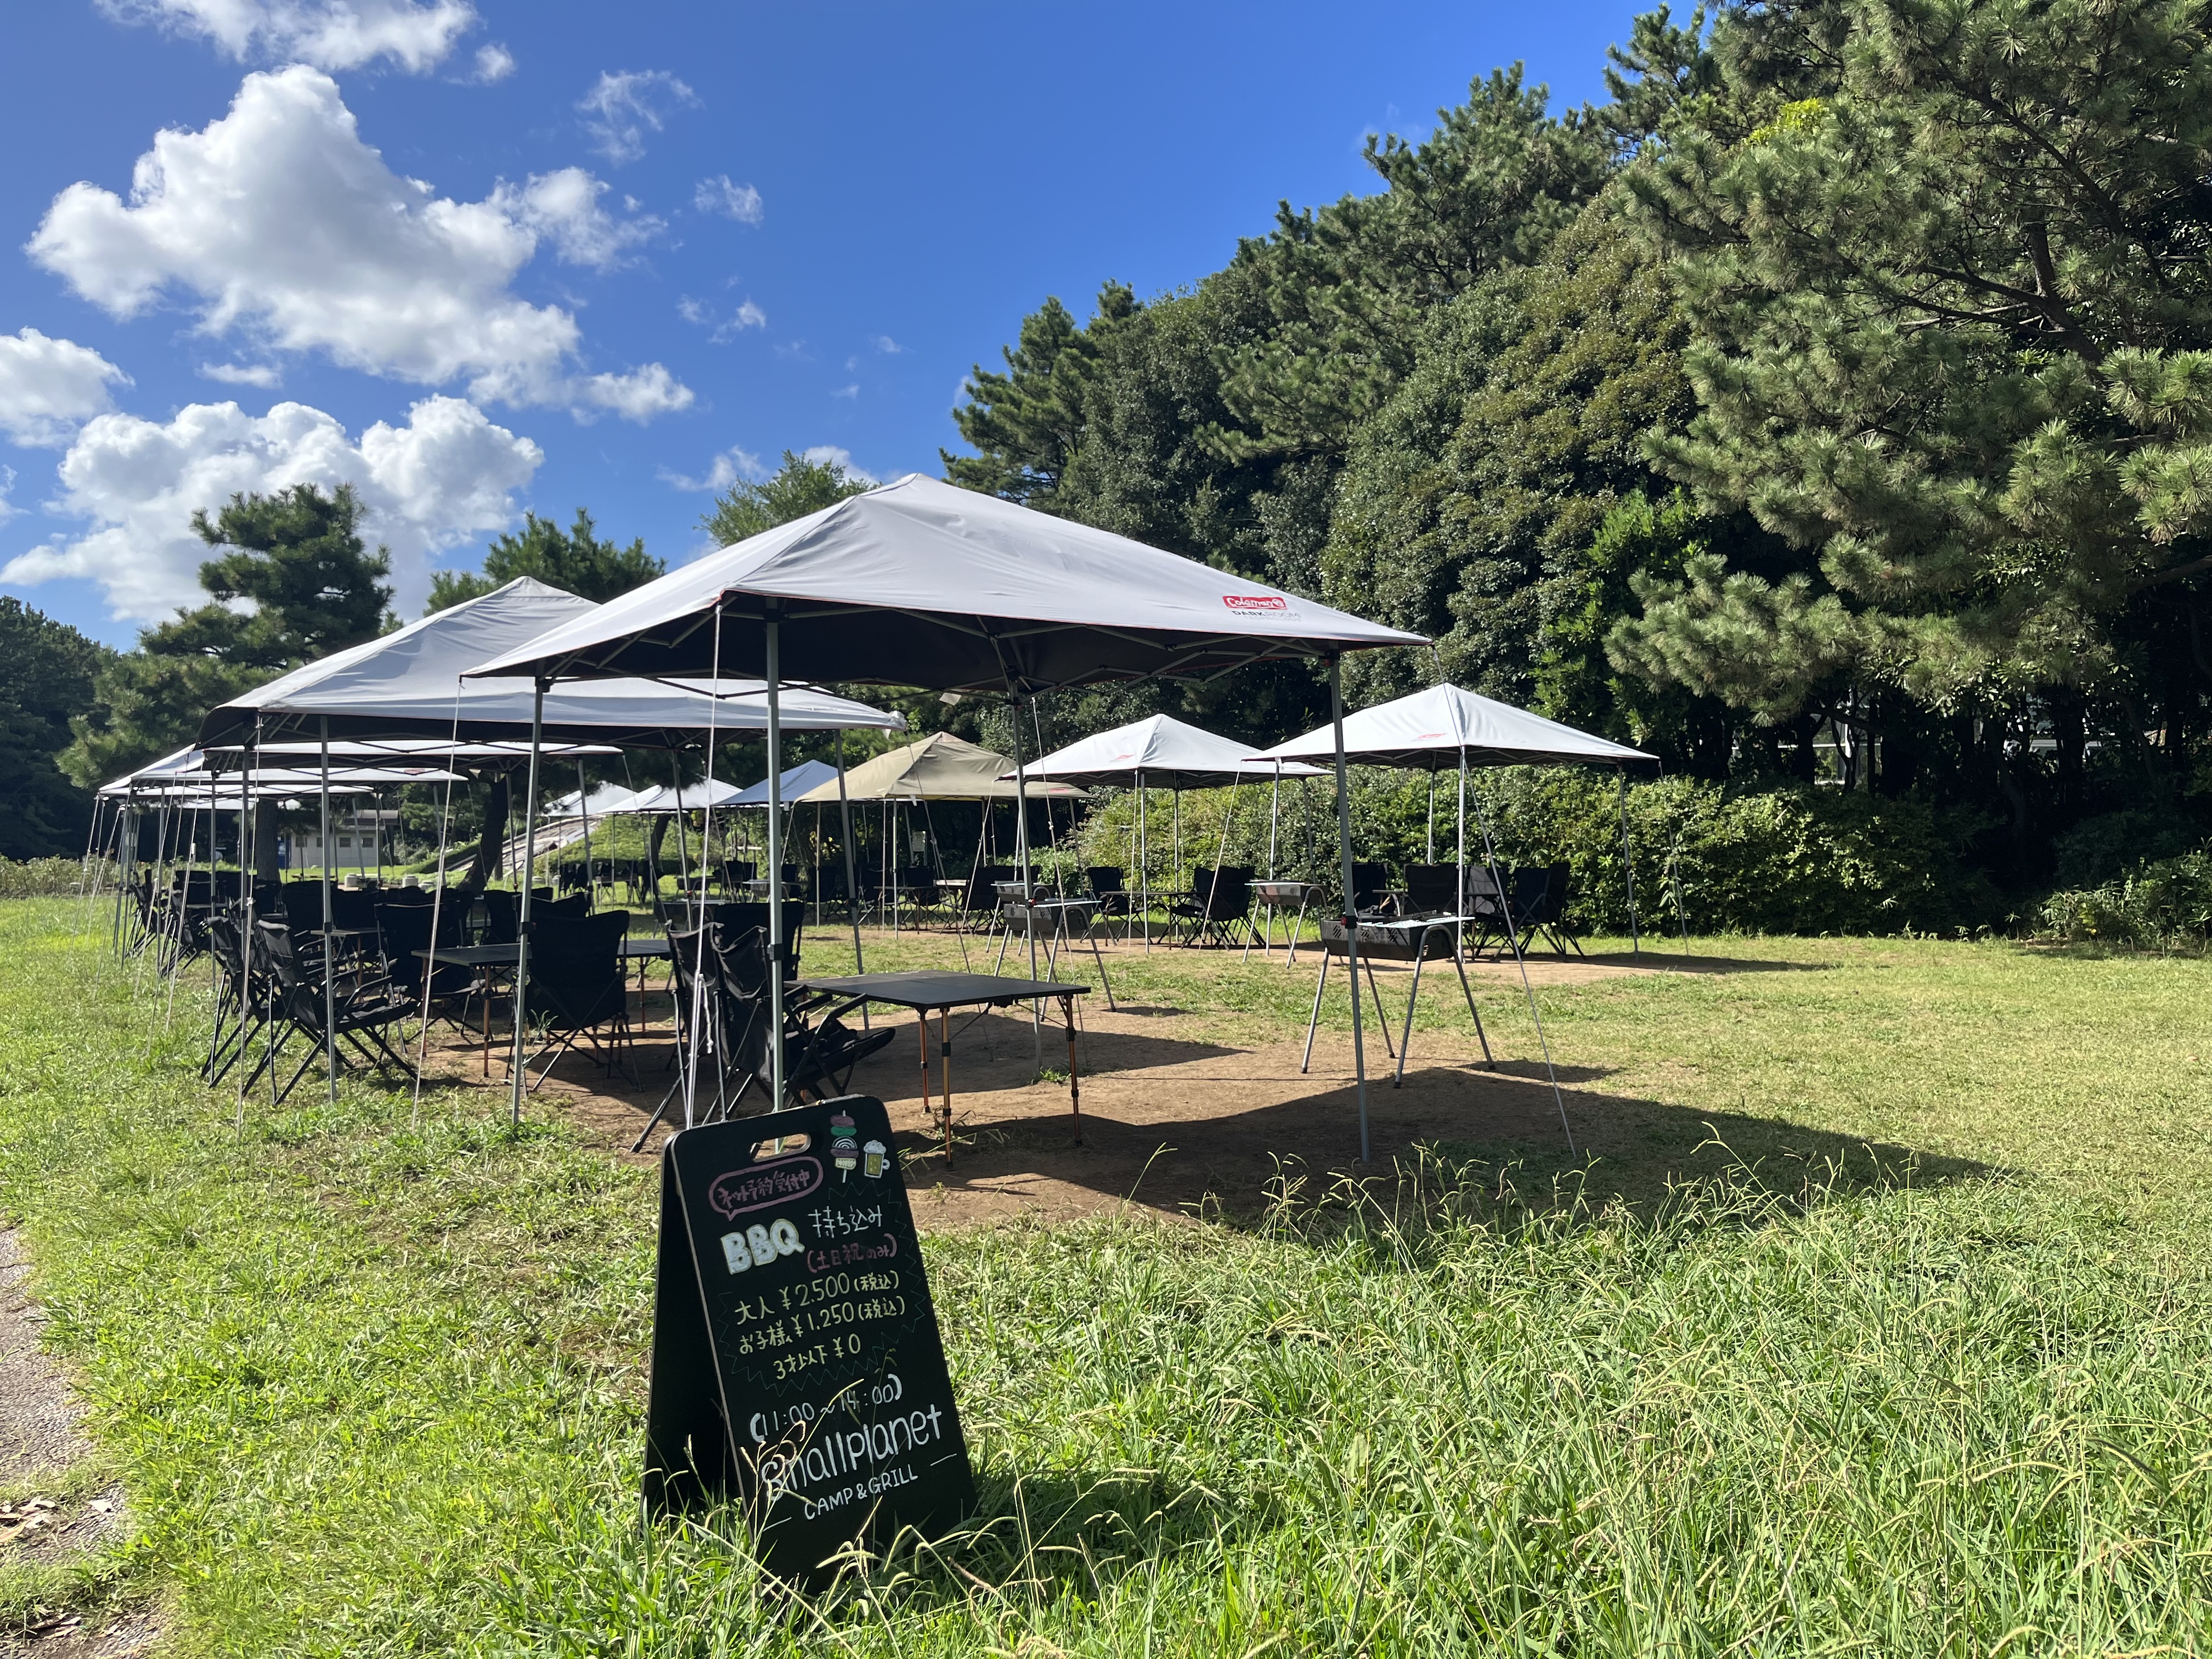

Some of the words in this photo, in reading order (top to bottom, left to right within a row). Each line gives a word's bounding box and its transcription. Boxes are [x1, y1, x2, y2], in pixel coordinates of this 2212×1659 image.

[1226, 596, 1273, 607] Coleman
[808, 1205, 883, 1239] 持ち込み
[720, 1218, 805, 1275] BBQ
